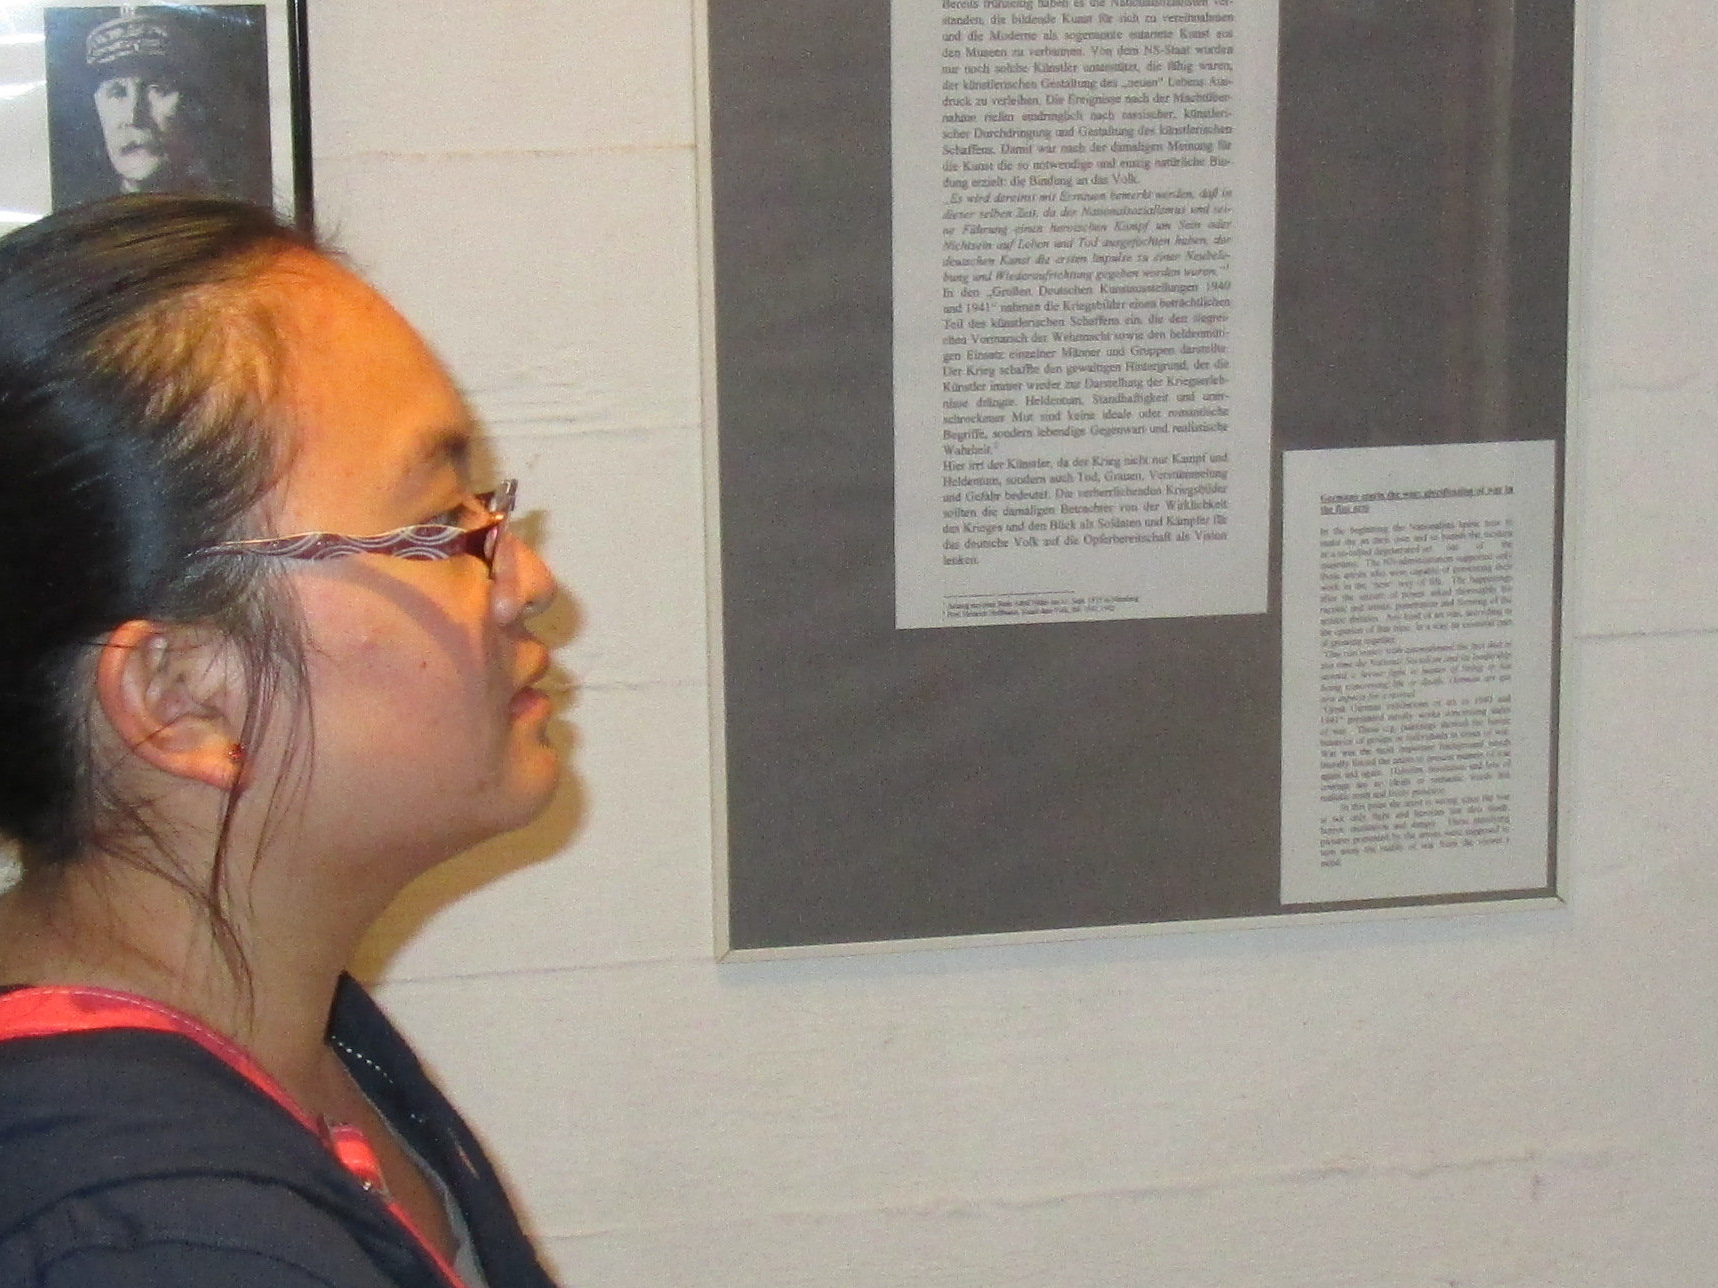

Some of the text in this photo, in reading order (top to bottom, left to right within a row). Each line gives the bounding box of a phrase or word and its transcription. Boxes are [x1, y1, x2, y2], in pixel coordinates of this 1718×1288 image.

[991, 14, 1006, 24] die
[1011, 14, 1055, 24] bildende
[1062, 13, 1092, 23] Kunst
[1099, 13, 1113, 23] für
[1119, 13, 1138, 22] sich
[1010, 176, 1025, 186] die
[1029, 175, 1072, 189] Bindung
[1091, 175, 1108, 184] das
[961, 287, 979, 297] den
[1039, 284, 1092, 295] Deutschen
[1044, 301, 1058, 311] die
